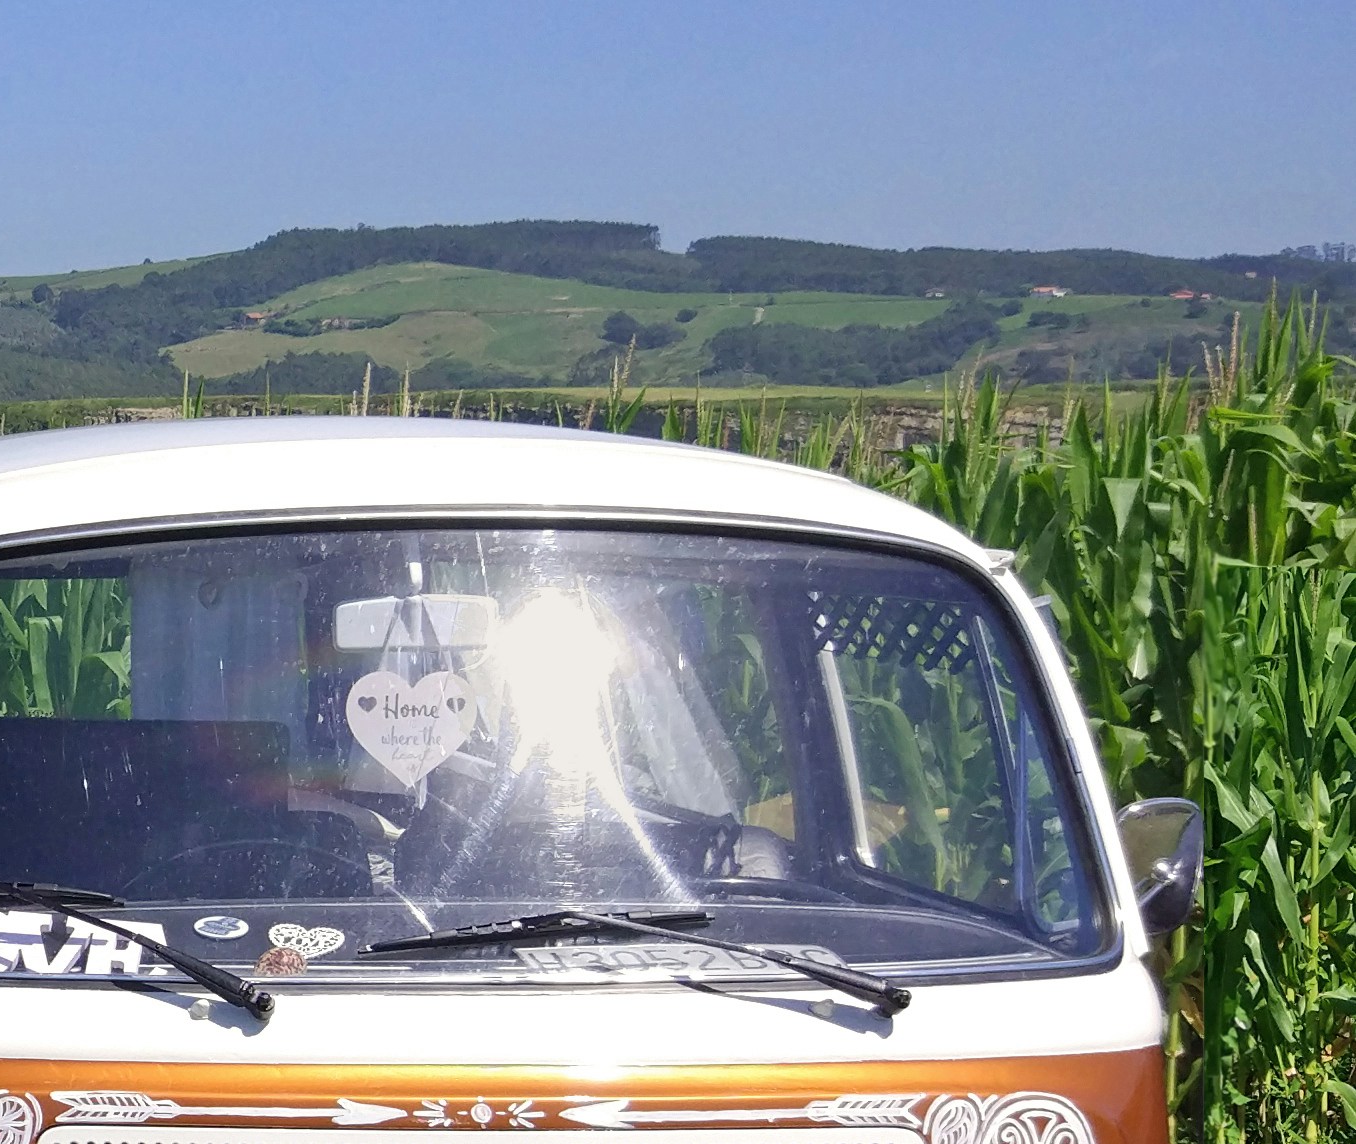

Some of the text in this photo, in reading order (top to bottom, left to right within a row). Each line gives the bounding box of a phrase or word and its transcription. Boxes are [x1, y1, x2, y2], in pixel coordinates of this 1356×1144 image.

[383, 693, 440, 719] Home
[381, 725, 442, 746] where the
